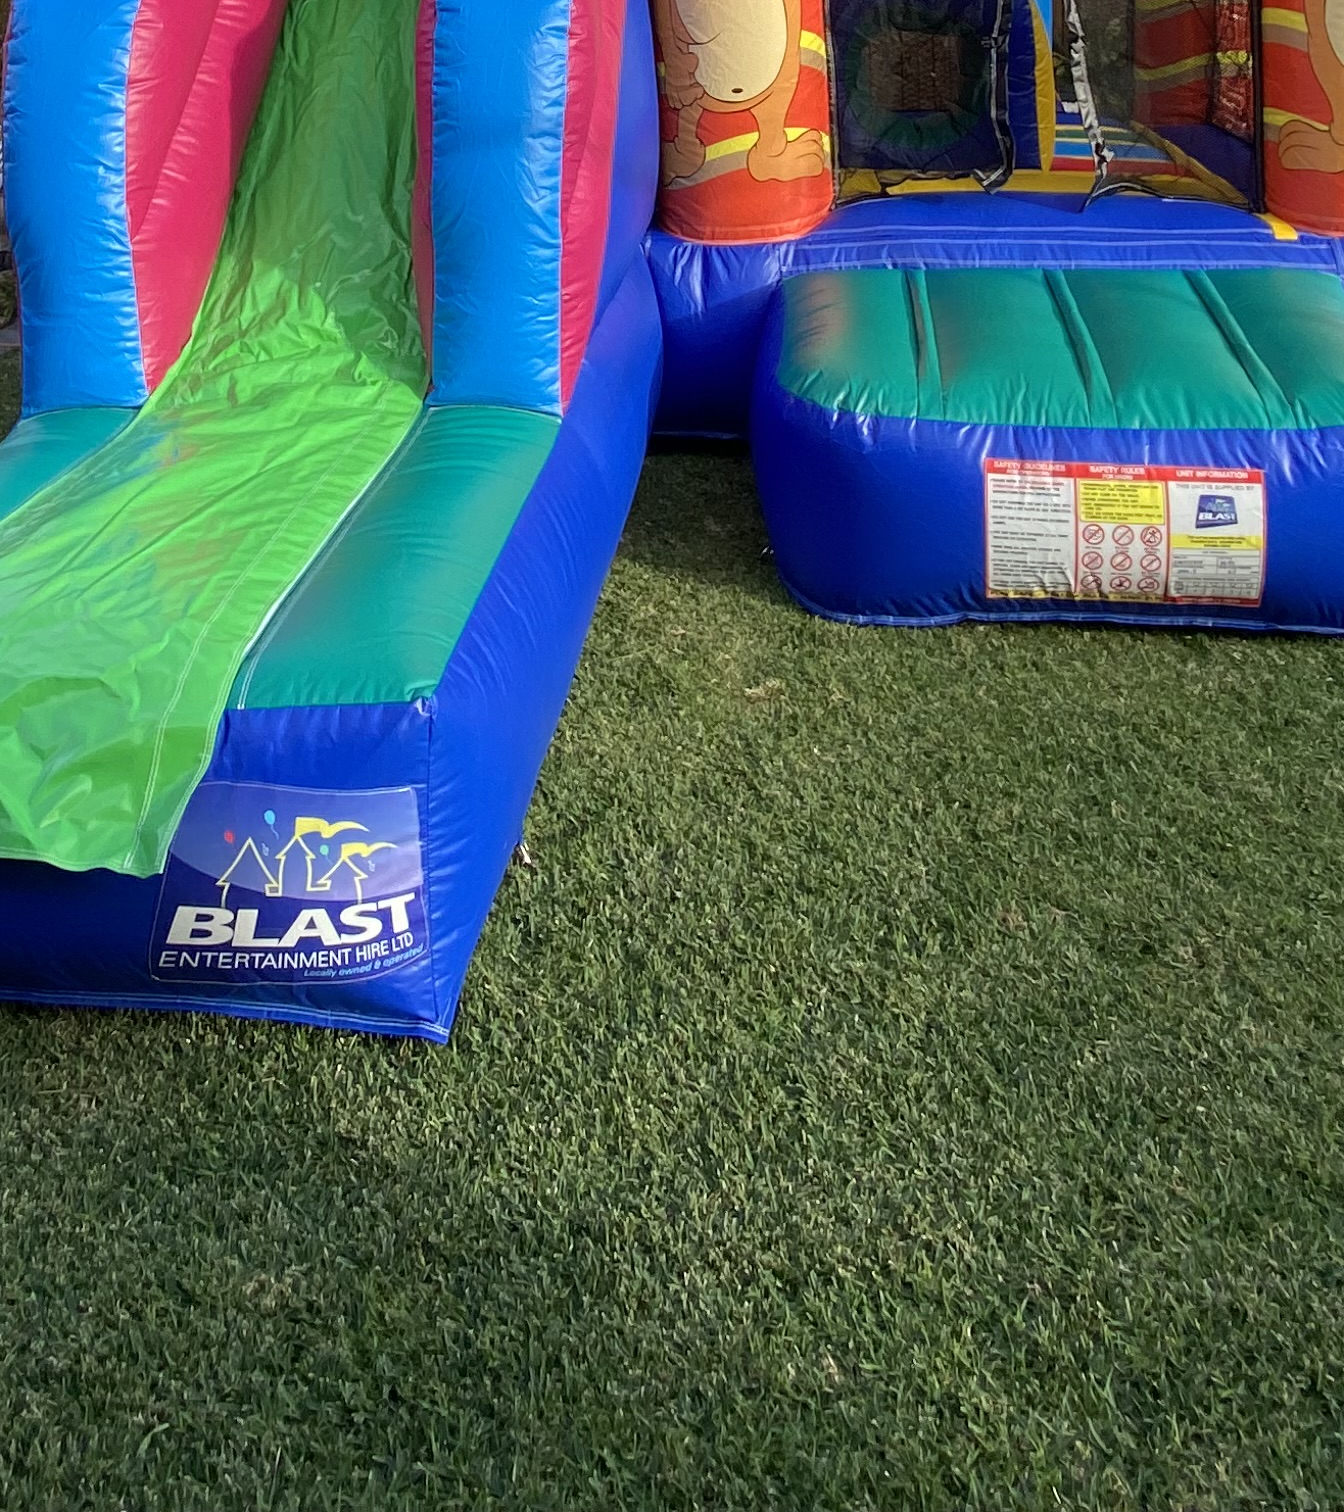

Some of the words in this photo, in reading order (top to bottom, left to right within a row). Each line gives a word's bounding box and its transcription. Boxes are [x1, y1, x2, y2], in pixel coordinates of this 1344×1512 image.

[1089, 465, 1119, 474] SAFETY
[1175, 470, 1194, 478] UNIT
[1195, 470, 1249, 479] INFORMATION
[1198, 512, 1236, 521] BLAST
[165, 892, 416, 948] BLAST
[158, 948, 353, 969] ENTERTAINMENT
[356, 939, 390, 963] HIRE
[391, 931, 414, 952] LTD
[303, 969, 337, 977] Locally
[338, 962, 373, 976] owned
[382, 943, 424, 967] operated
